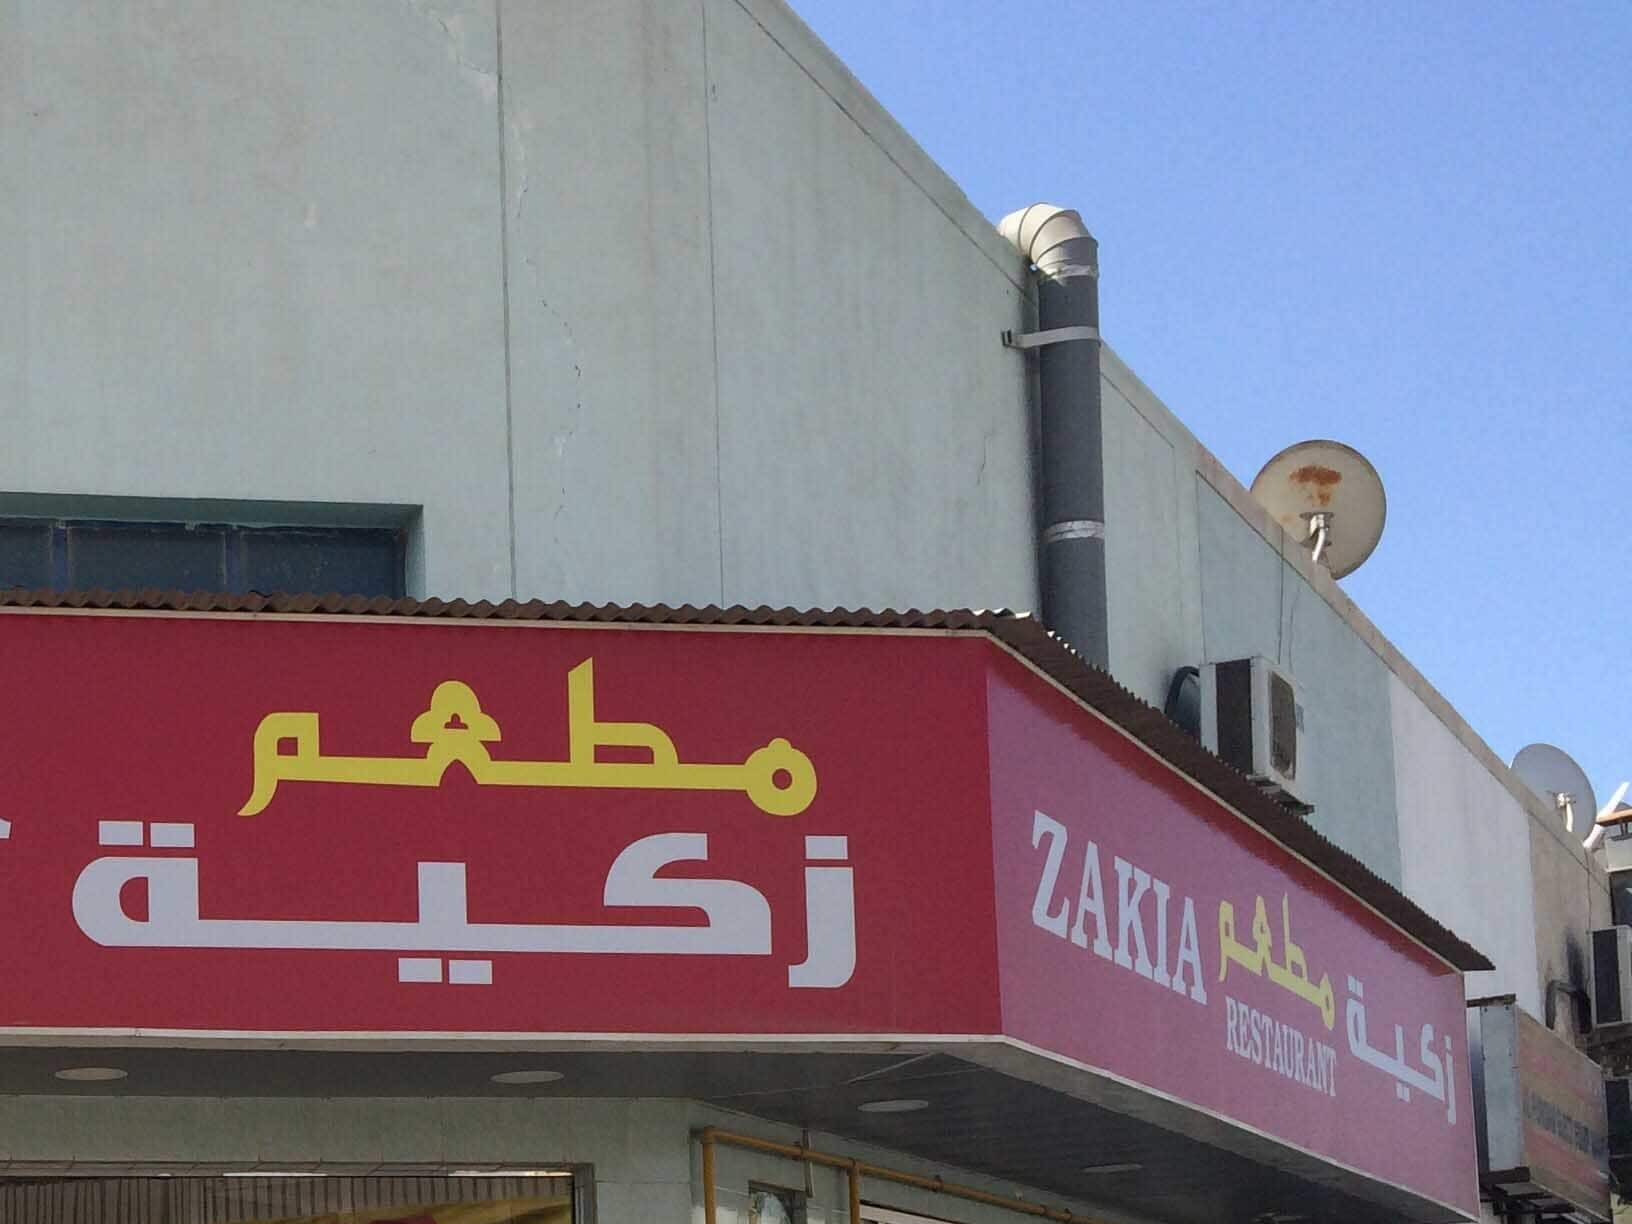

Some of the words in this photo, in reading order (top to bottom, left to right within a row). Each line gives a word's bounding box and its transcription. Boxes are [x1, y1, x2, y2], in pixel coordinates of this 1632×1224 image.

[237, 657, 817, 817] مطعم
[71, 820, 857, 988] زكية
[1031, 810, 1208, 1006] ZAKIA
[1217, 892, 1335, 1031] مطعم
[1225, 997, 1338, 1098] RESTAURANT
[1345, 975, 1457, 1126] زكية
